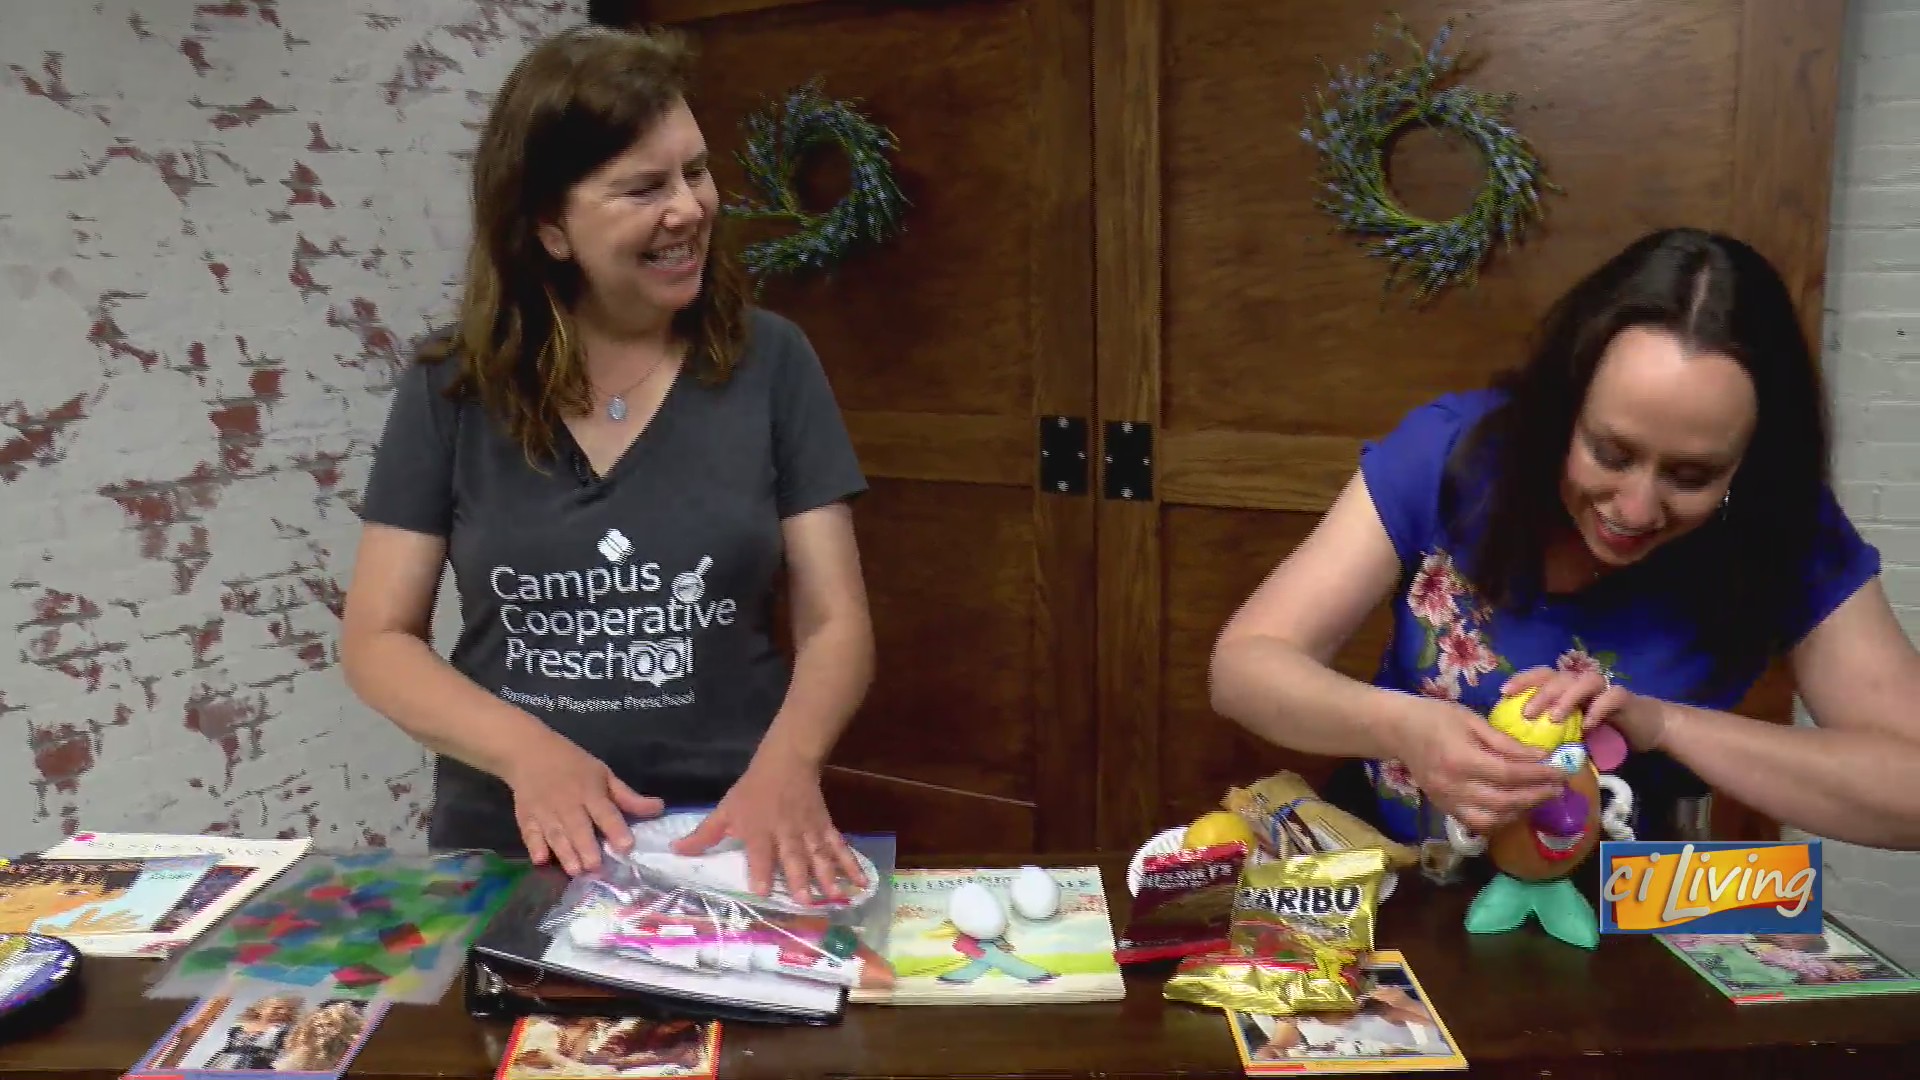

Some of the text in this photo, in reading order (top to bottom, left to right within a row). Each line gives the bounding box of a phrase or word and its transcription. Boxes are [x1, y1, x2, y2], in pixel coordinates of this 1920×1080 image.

[490, 562, 662, 603] Campus
[500, 598, 736, 645] Cooperative
[506, 637, 694, 684] Preschool
[500, 685, 696, 713] Formerly Playtime Preschool
